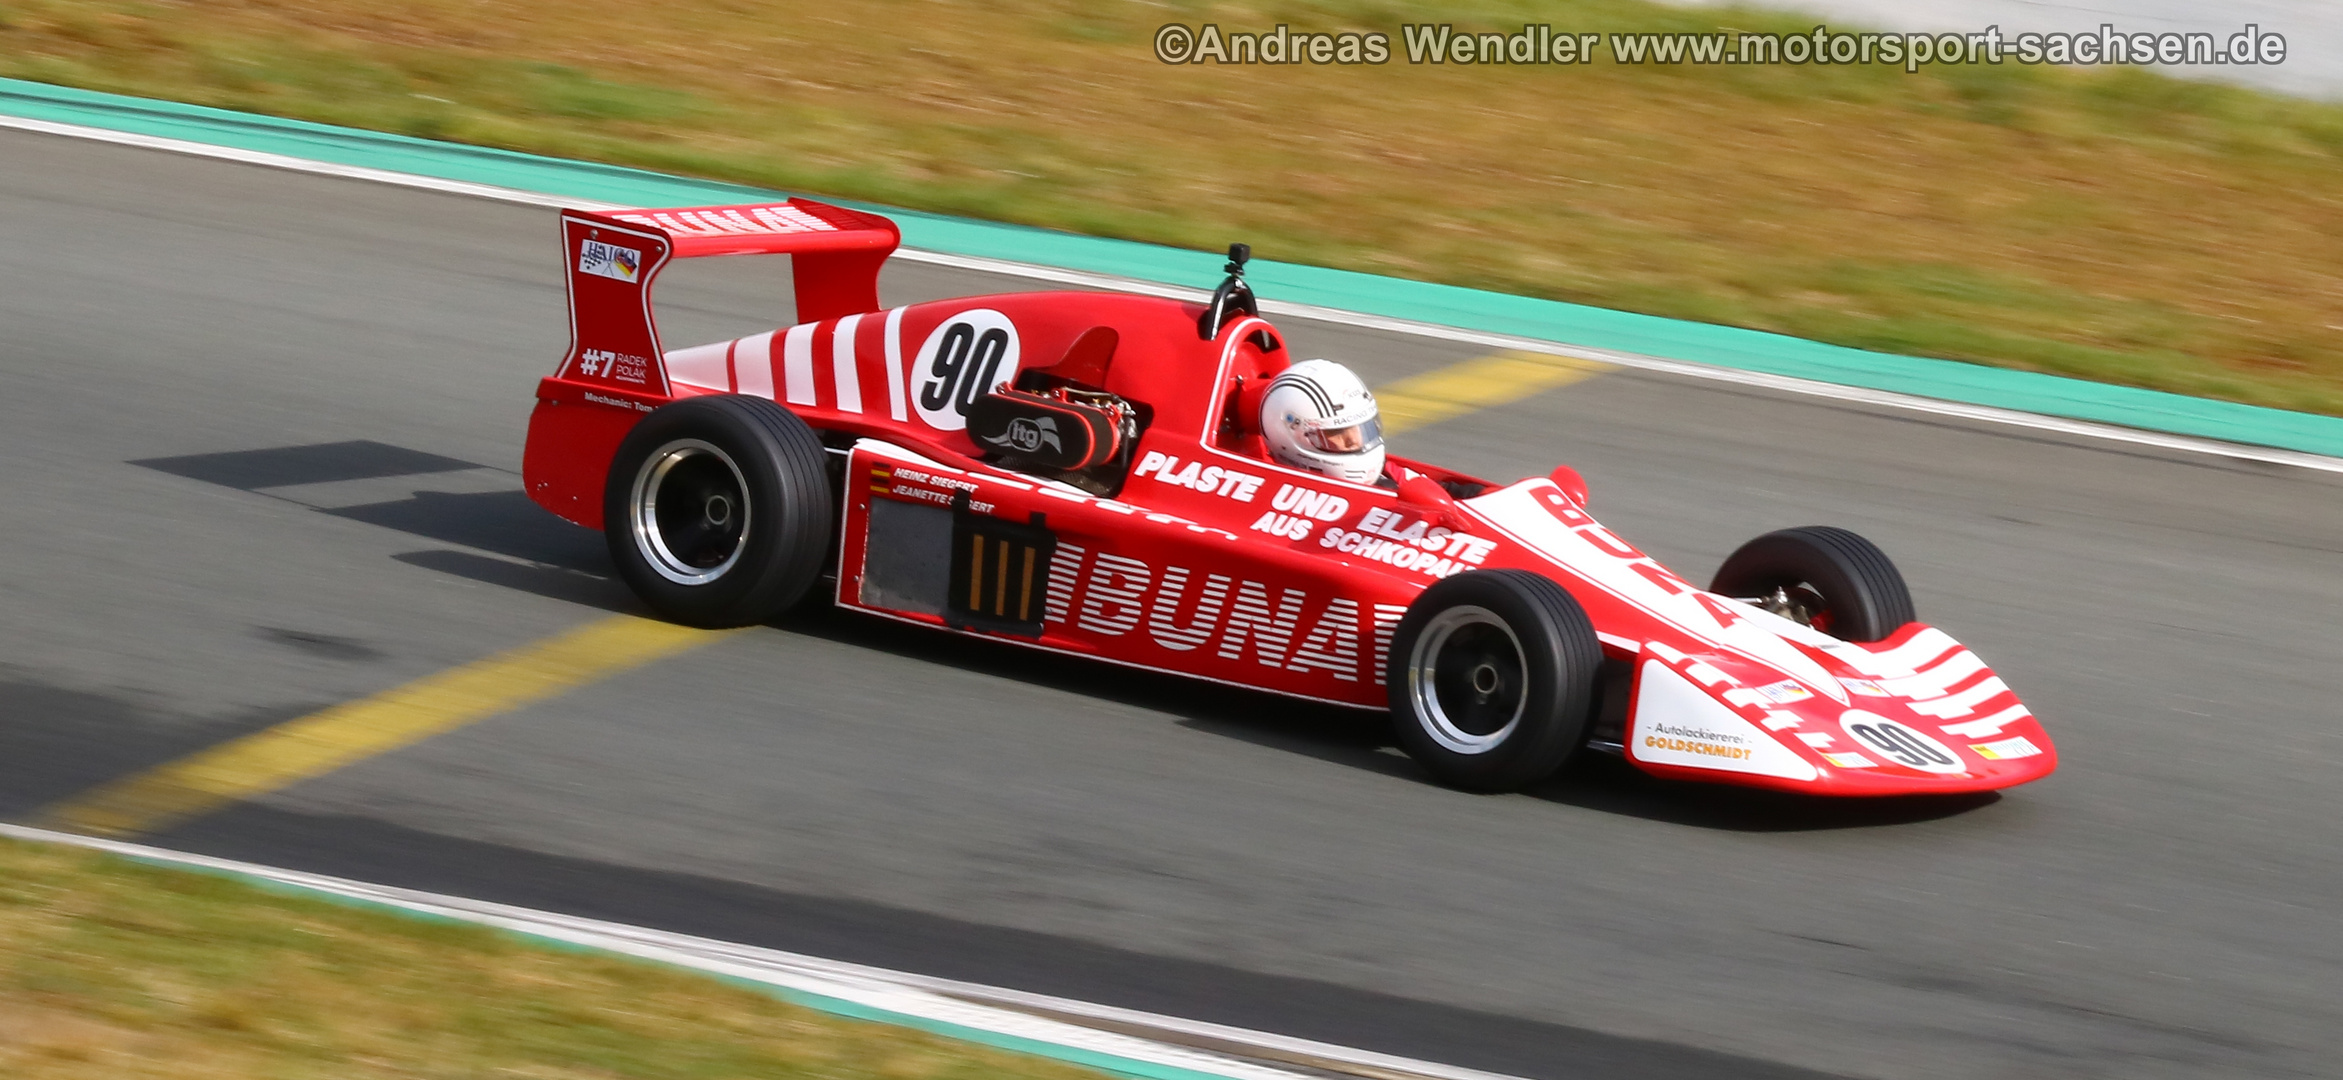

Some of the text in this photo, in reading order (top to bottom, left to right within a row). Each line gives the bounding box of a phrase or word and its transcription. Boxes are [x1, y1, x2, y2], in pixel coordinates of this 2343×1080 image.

[580, 348, 616, 378] #7
[617, 353, 647, 367] RADEK
[920, 323, 1009, 417] 90
[584, 392, 632, 409] Mechanic:
[1012, 421, 1038, 448] itg
[893, 468, 979, 493] HEINZ SIEGERT
[892, 485, 948, 504] JEANETTE
[1134, 451, 1497, 565] PLASTE UND ELASTE
[1250, 511, 1313, 541] AUS
[1655, 723, 1744, 744] Autolackiererei
[1850, 723, 1955, 766] 90
[1645, 736, 1751, 760] GOLDSCHMIDT
